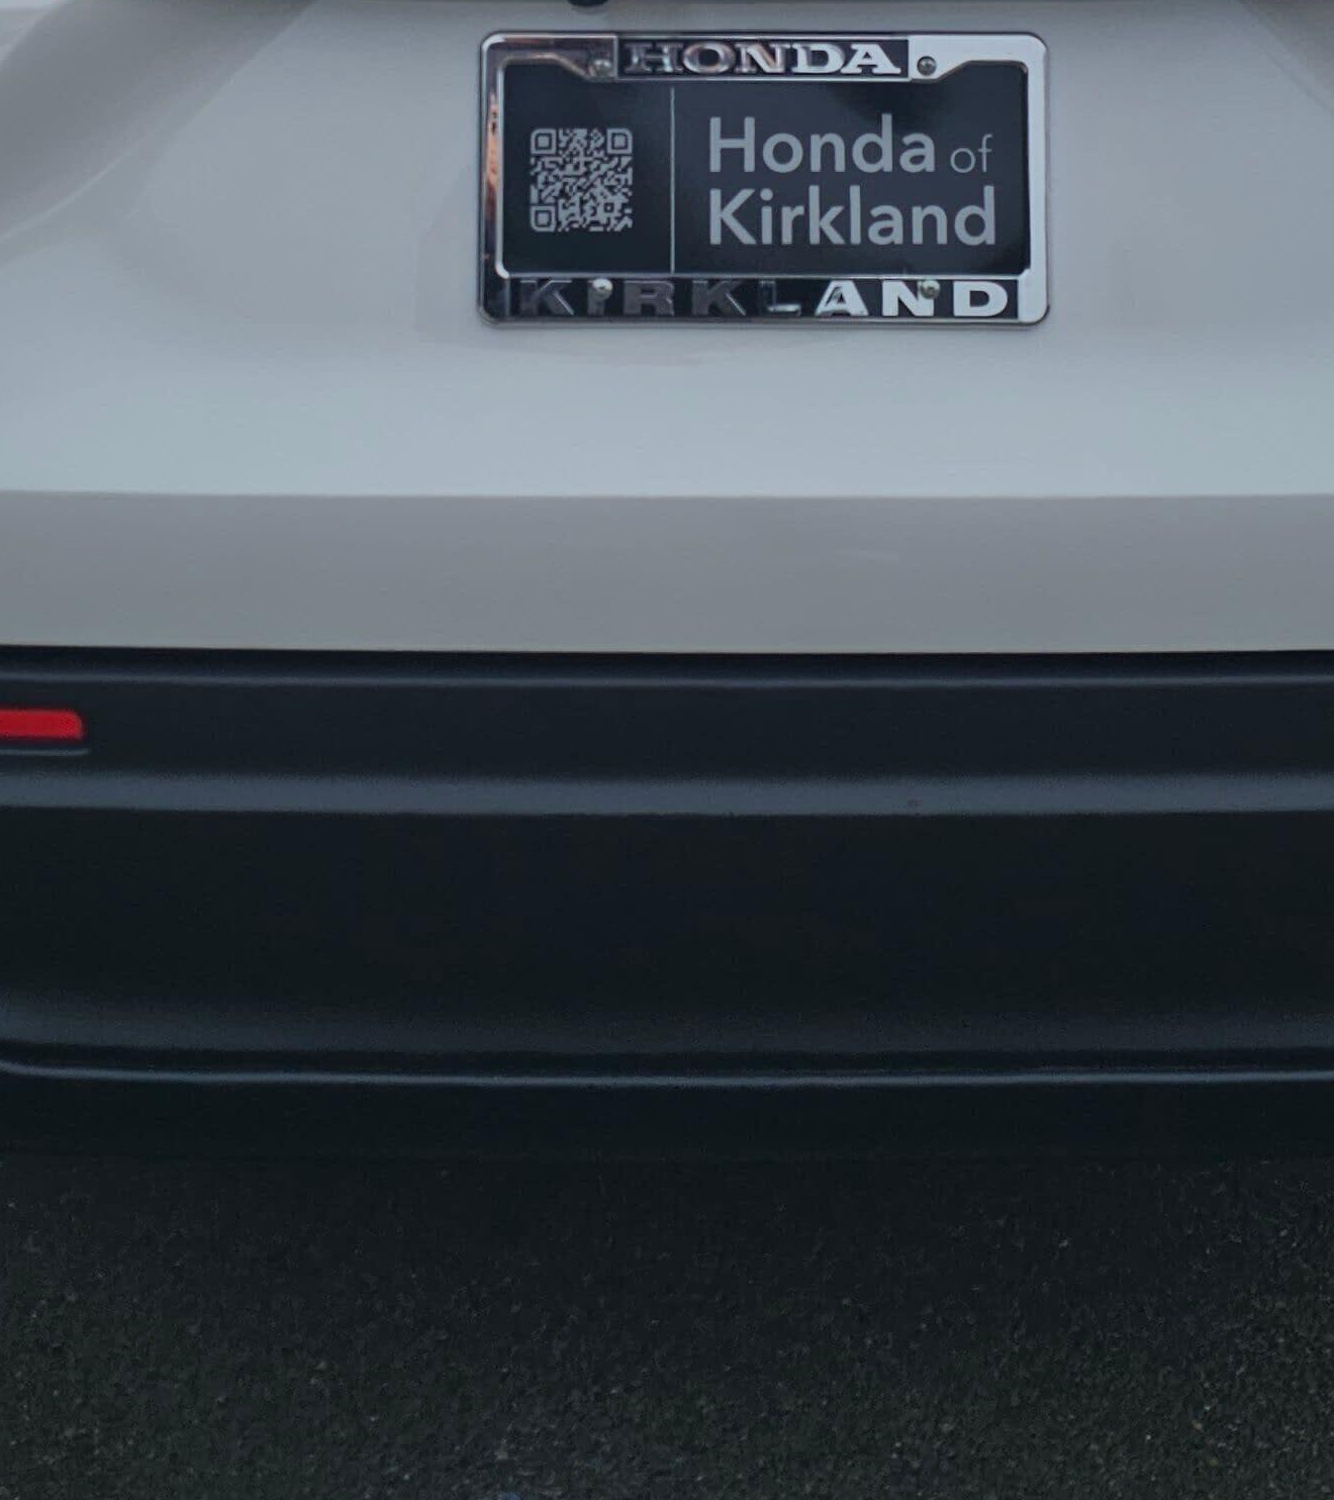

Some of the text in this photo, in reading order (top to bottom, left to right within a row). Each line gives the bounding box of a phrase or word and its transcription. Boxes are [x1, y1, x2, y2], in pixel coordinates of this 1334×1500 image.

[625, 43, 901, 74] HONDA
[709, 113, 993, 174] Honda of
[709, 185, 996, 246] Kirkland
[519, 279, 1008, 318] KIRKLAND
